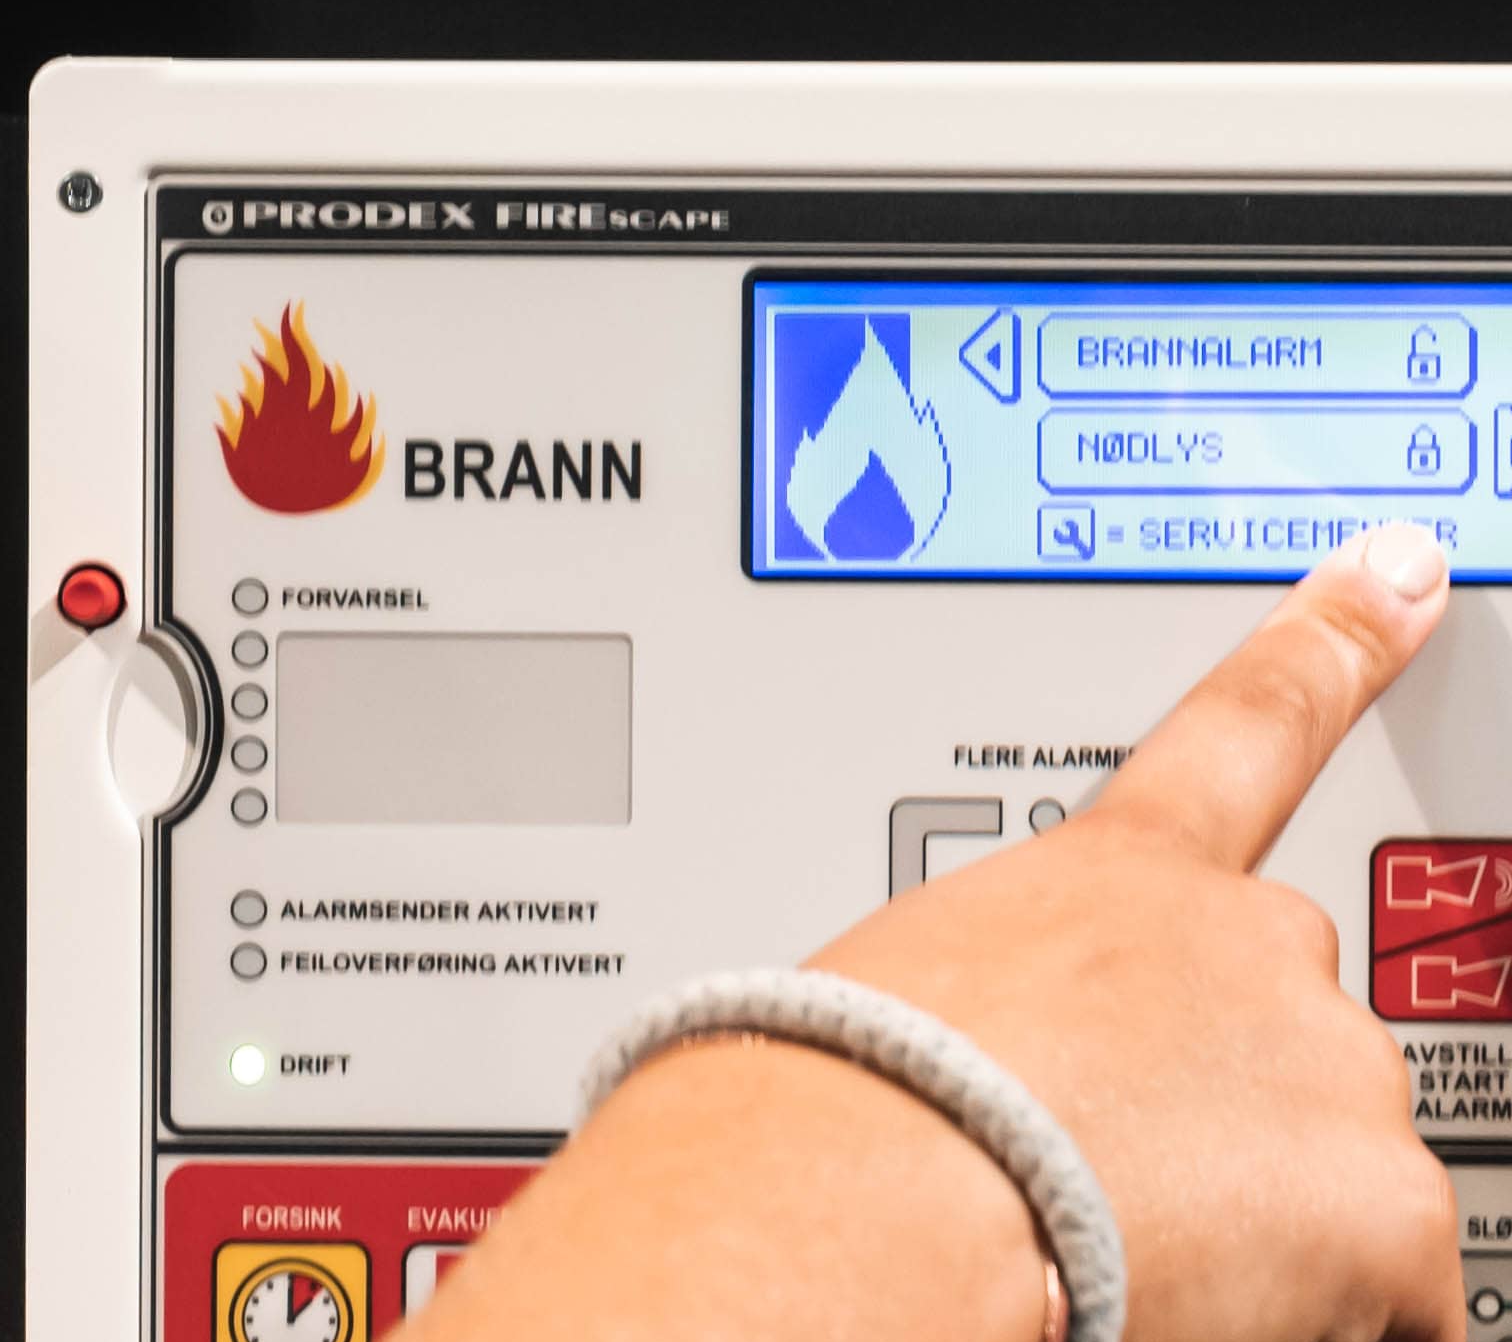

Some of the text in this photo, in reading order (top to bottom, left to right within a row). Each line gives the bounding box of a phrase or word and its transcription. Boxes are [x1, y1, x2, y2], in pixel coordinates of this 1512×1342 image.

[243, 201, 475, 229] PRODEX
[1077, 336, 1323, 369] BRANNALARM
[1077, 431, 1223, 464] NØDLYS
[404, 438, 642, 502] BRANN
[1139, 517, 1458, 551] SERVICEMER
[281, 588, 426, 610] FORVARSEL
[953, 745, 1024, 768] FLERE
[280, 899, 597, 922] ALARMSENDER AKTIVERT
[280, 951, 624, 975] FEILOVERFØRING AKTIVERT
[280, 1054, 350, 1075] DRIFT
[1419, 1069, 1507, 1093] START
[1415, 1096, 1512, 1121] ALARM
[242, 1205, 342, 1231] FORSINK
